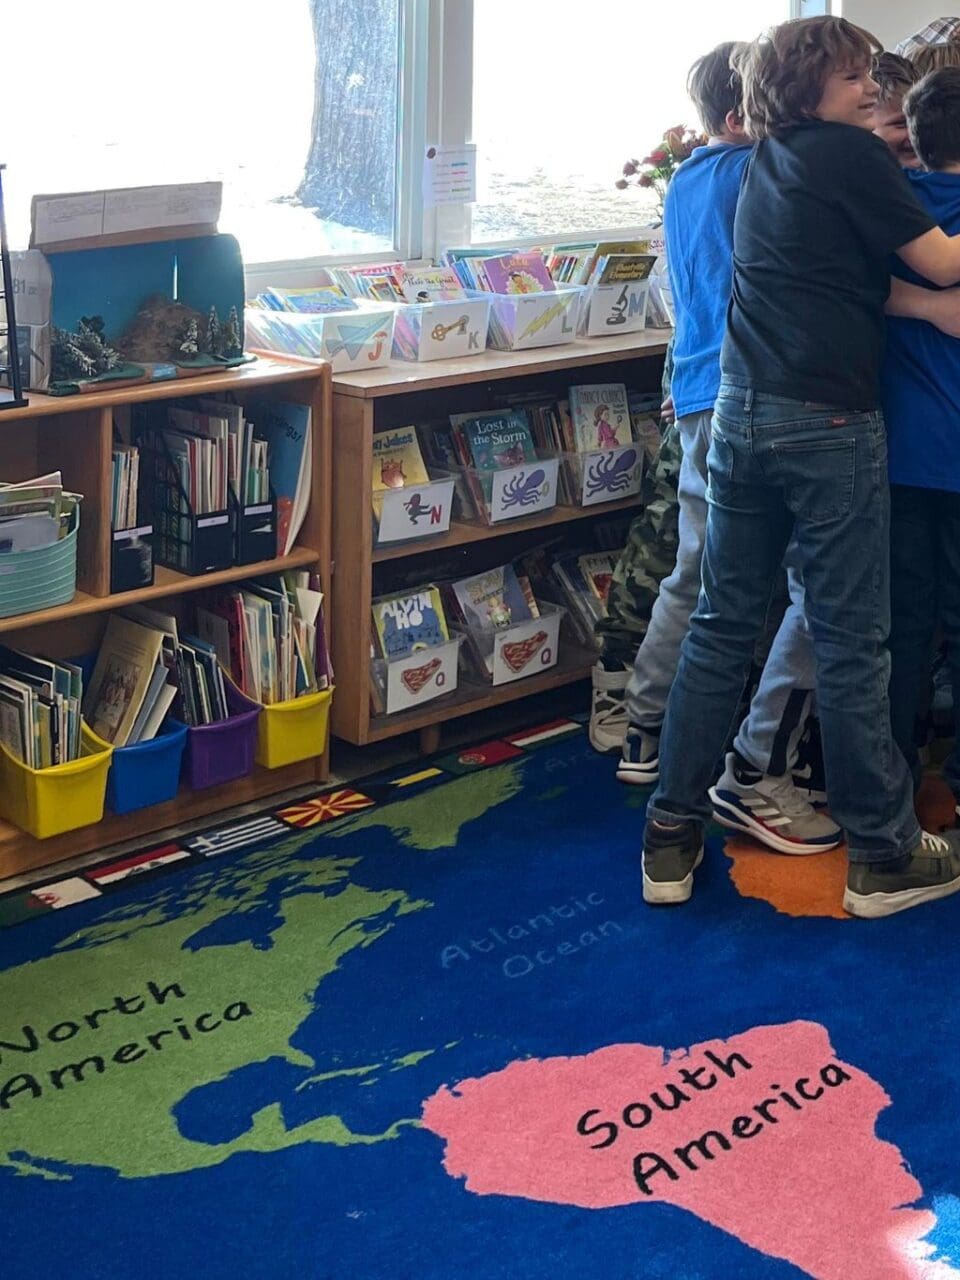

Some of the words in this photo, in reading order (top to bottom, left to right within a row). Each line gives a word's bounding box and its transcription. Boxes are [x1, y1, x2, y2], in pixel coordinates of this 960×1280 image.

[628, 291, 645, 318] M
[562, 316, 573, 334] L
[368, 331, 388, 361] J
[468, 331, 480, 350] K
[473, 435, 490, 446] the
[492, 431, 527, 445] Storm
[476, 420, 503, 435] Lost
[507, 416, 517, 429] in
[430, 505, 442, 525] N
[441, 892, 604, 968] Atlantic
[503, 921, 623, 978] Ocean
[0, 1001, 252, 1109] America
[577, 1050, 753, 1149] South
[633, 1063, 851, 1195] America
